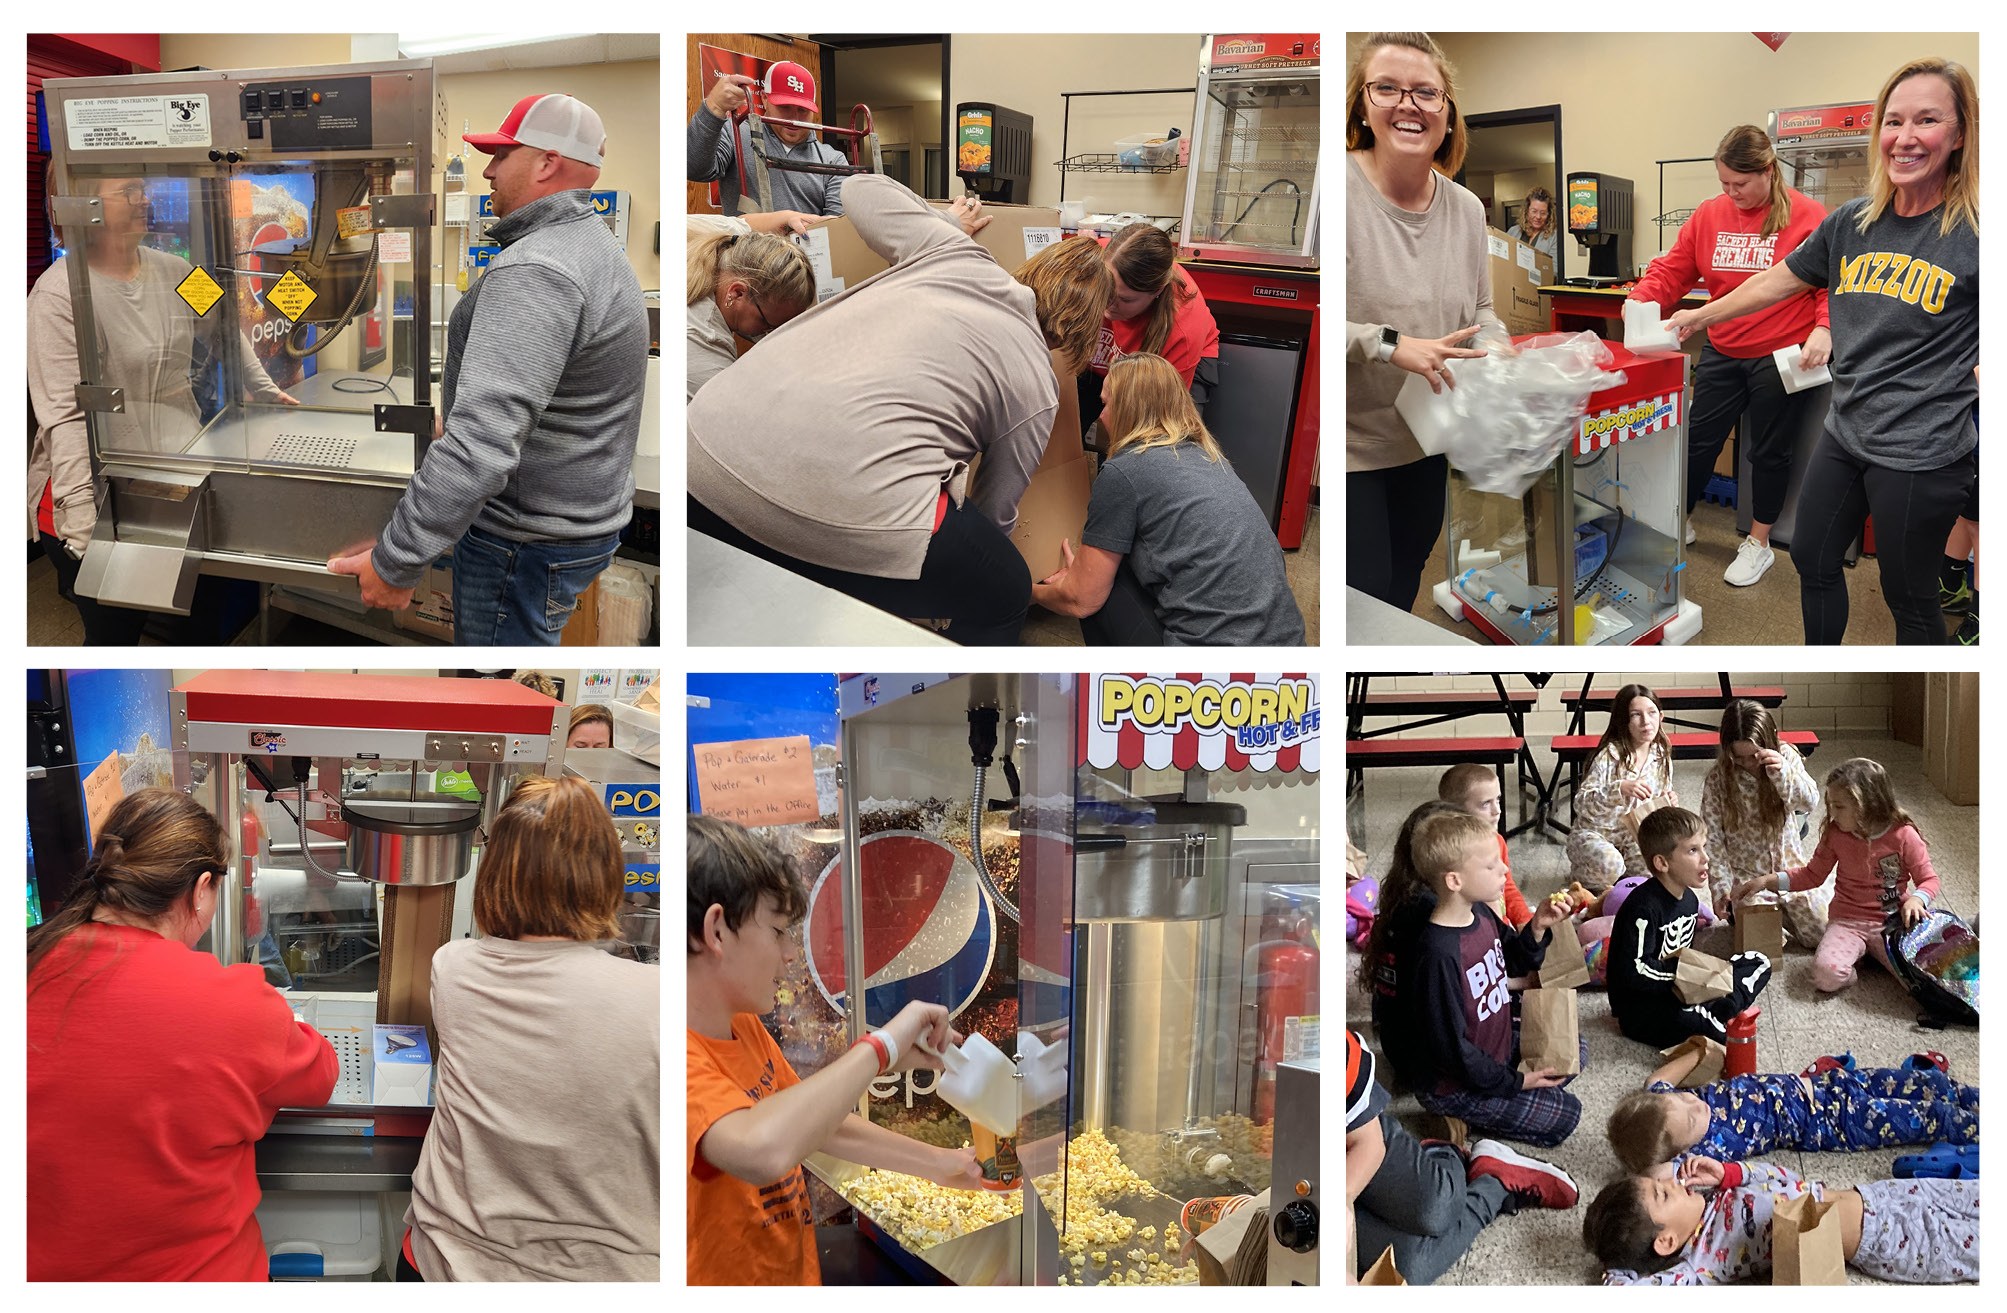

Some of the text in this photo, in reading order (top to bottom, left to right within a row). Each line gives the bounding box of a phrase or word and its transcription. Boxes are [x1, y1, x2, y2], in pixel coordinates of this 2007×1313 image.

[1217, 44, 1264, 56] Bavarian
[1279, 60, 1311, 68] PRETZELS
[170, 100, 200, 110] Big Eye
[965, 127, 984, 135] NACHO
[1782, 119, 1820, 128] Bavarian
[1716, 234, 1747, 247] SACRED
[1711, 247, 1775, 270] GREMLINS
[1834, 252, 1956, 315] MIZZOU
[1256, 288, 1296, 298] CRAFTSMAN
[251, 318, 292, 350] peps
[1584, 402, 1655, 438] POPCORN
[1632, 420, 1646, 431] HOT
[1652, 404, 1673, 420] FRESH
[1102, 680, 1309, 730] POPCORN
[254, 733, 286, 744] Classic
[1238, 722, 1280, 746] HOT
[1281, 720, 1298, 740] &
[704, 752, 722, 770] Pop
[711, 780, 740, 792] Water
[610, 790, 660, 813] PO
[736, 808, 749, 820] pay
[766, 804, 778, 813] the
